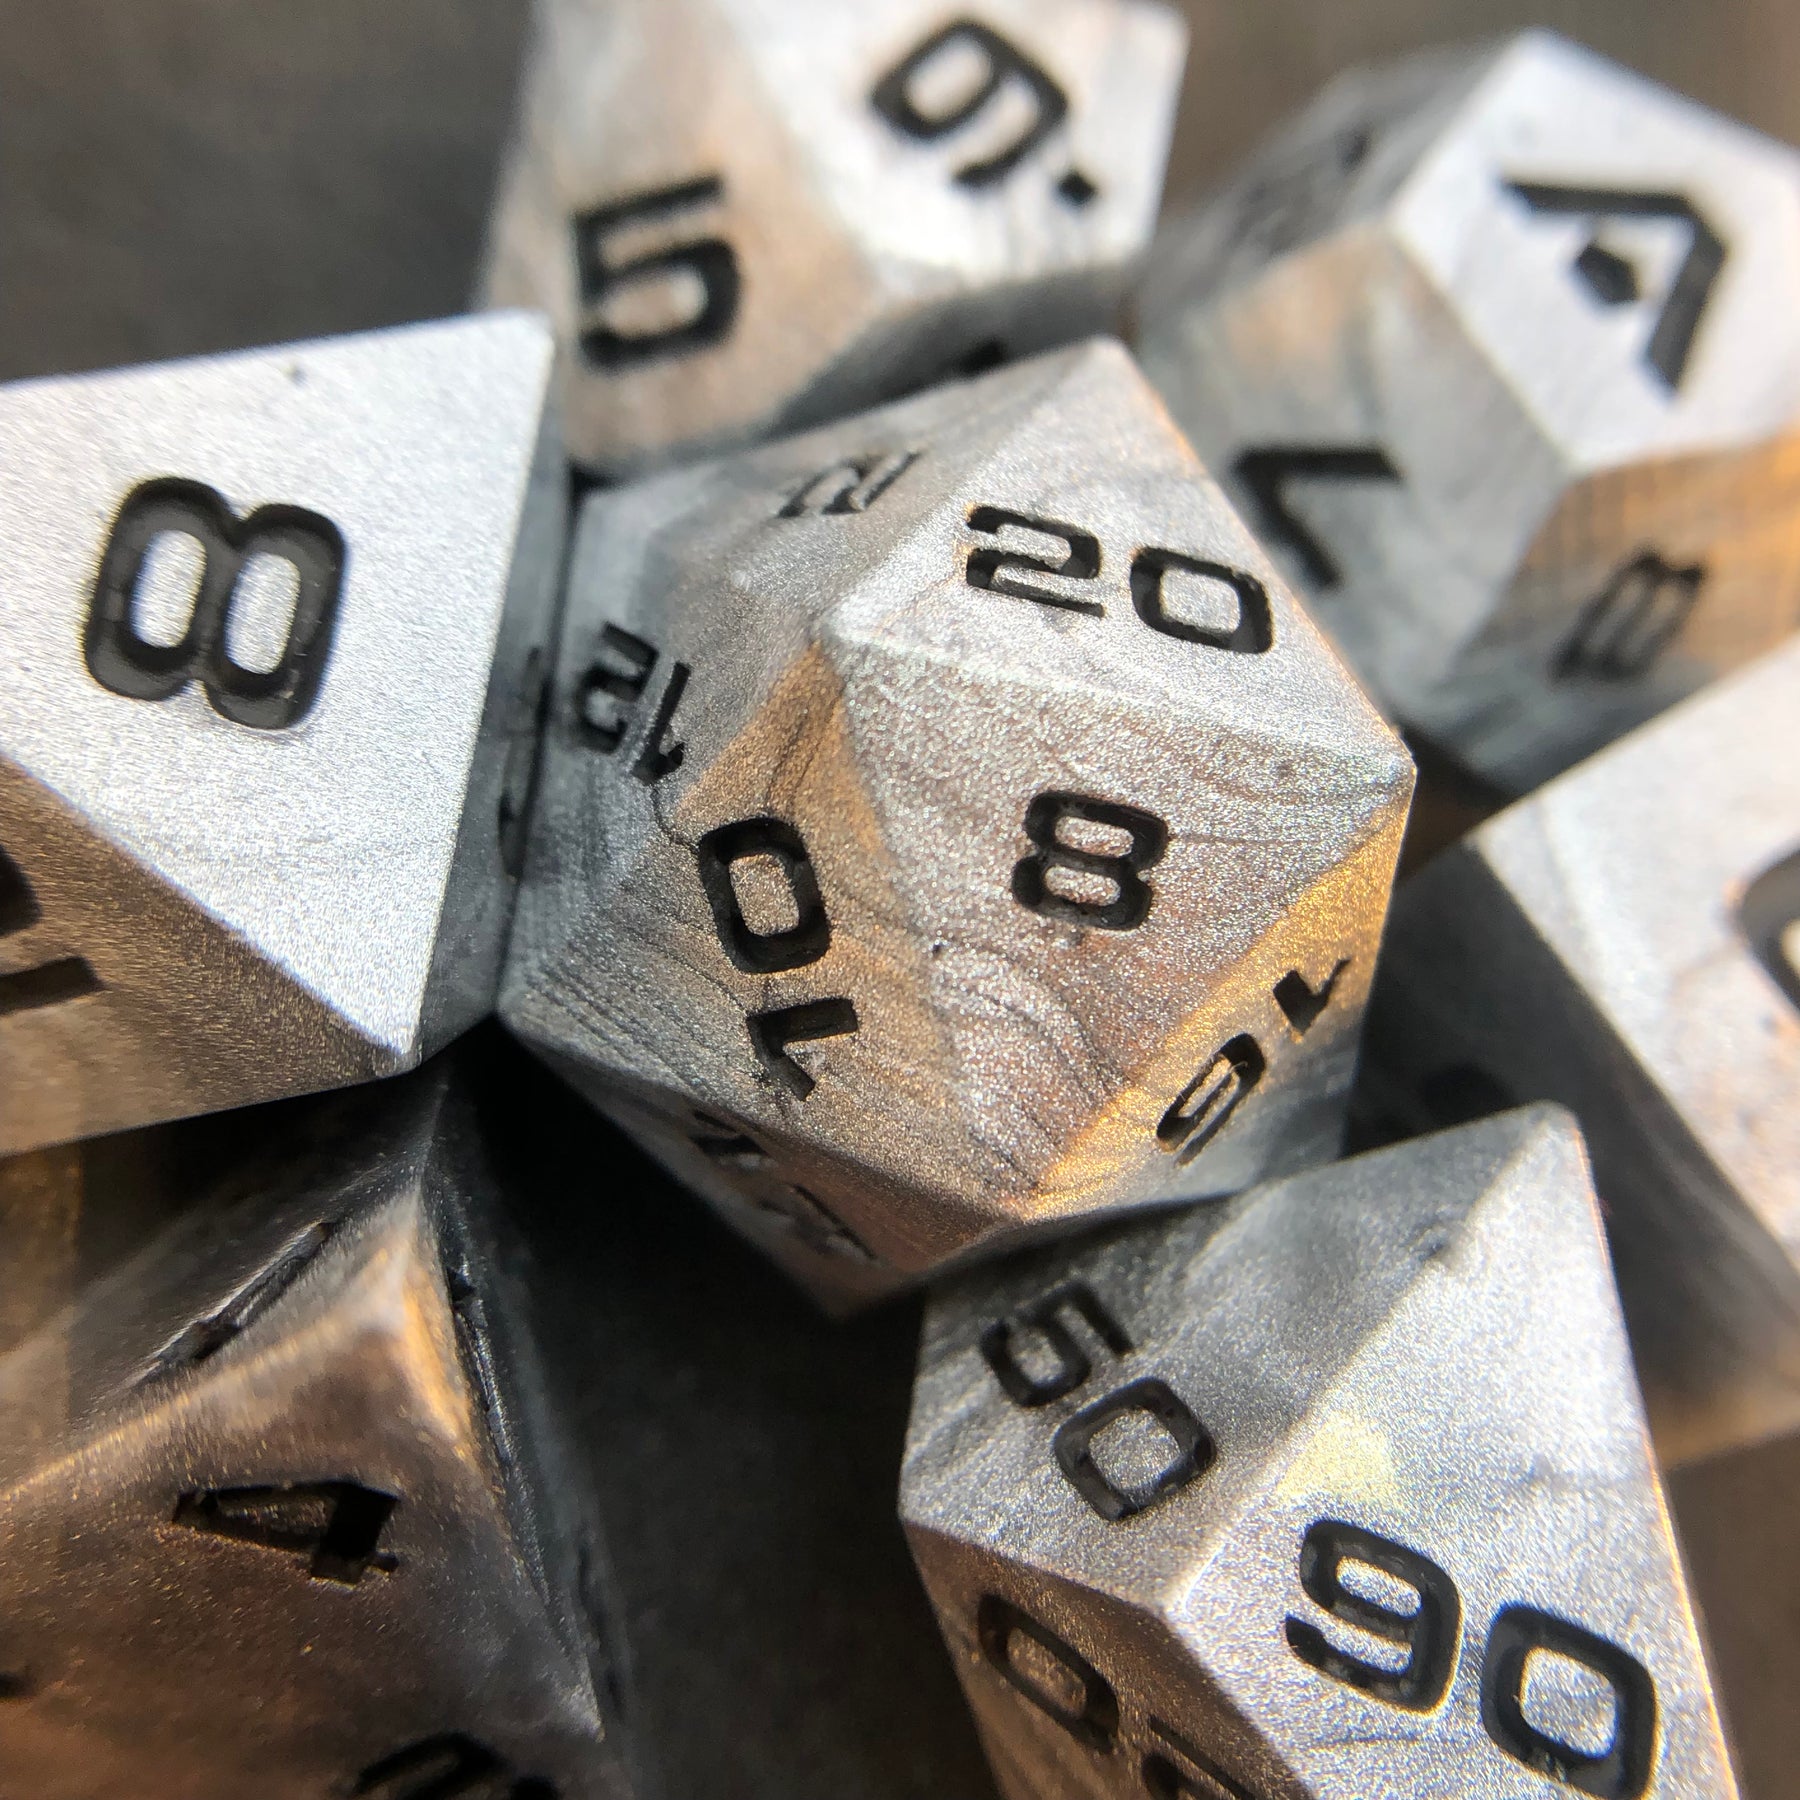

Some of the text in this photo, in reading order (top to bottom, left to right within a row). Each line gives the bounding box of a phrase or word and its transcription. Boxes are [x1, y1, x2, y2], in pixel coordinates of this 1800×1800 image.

[573, 173, 741, 374] 5
[82, 475, 346, 730] 8
[966, 504, 1276, 655] 20
[575, 620, 692, 787] 12
[698, 815, 860, 1102] 10
[1012, 790, 1168, 932] 8
[1156, 957, 1350, 1168] 16
[980, 1280, 1217, 1522] 50
[170, 1478, 400, 1587] 4
[1285, 1519, 1660, 1800] 90
